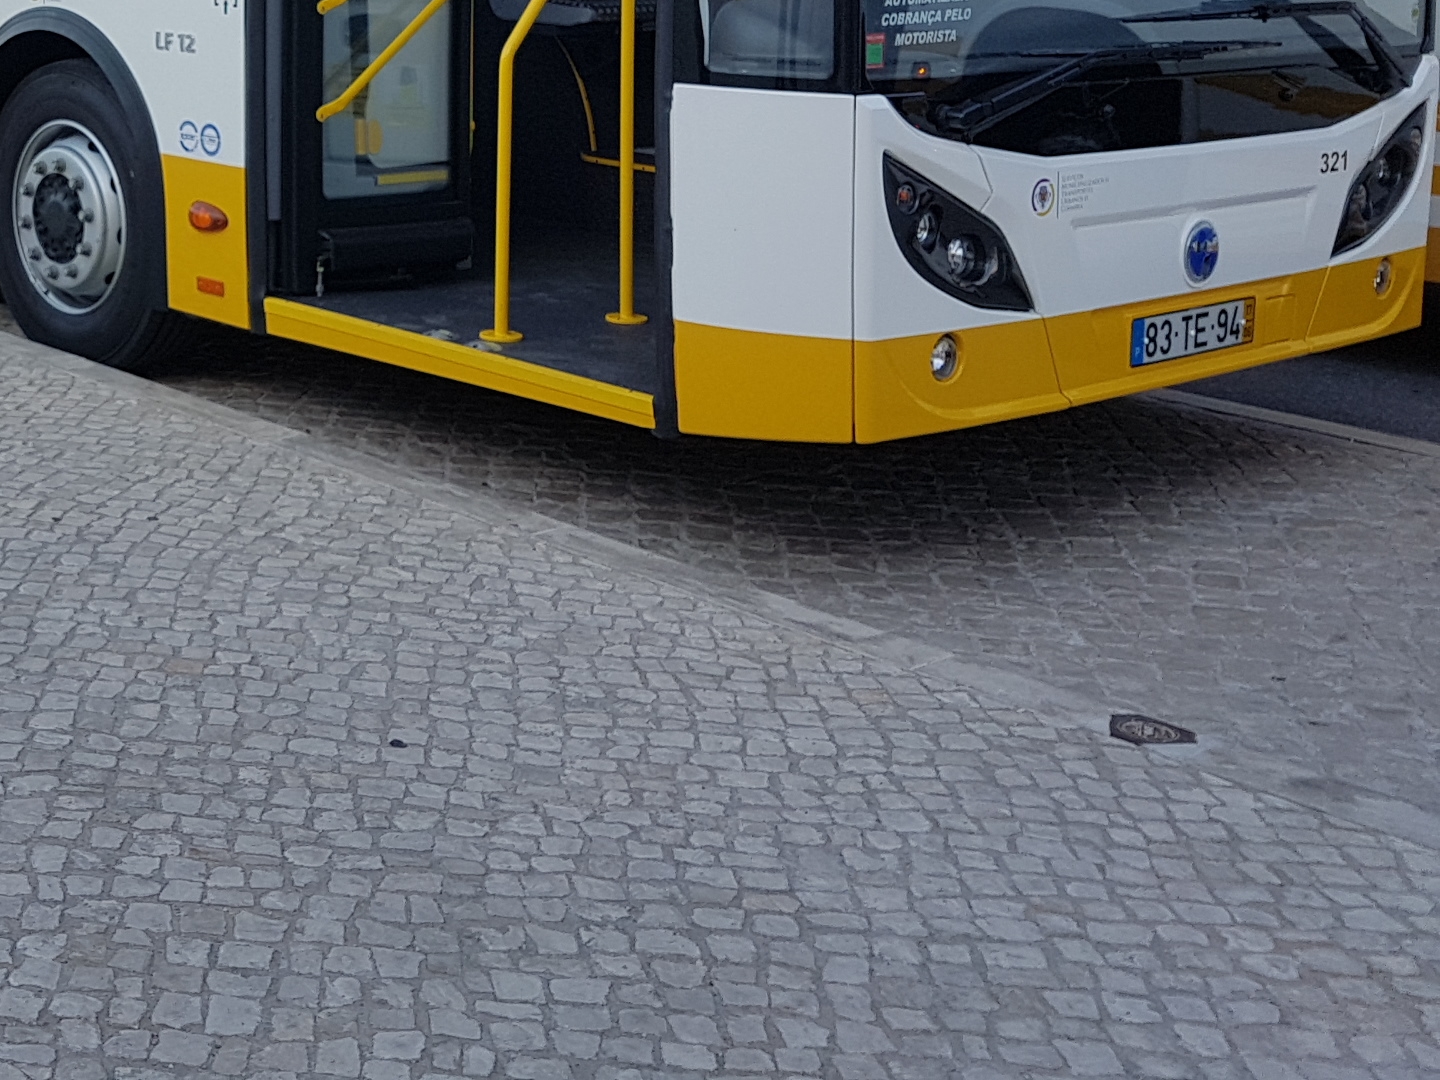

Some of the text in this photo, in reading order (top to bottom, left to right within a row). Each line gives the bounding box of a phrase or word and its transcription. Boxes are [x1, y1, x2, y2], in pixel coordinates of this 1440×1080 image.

[881, 8, 972, 27] COBRANÇA PELO
[155, 31, 196, 54] LF 12
[894, 30, 957, 46] MOTORISTA
[1320, 150, 1348, 174] 321
